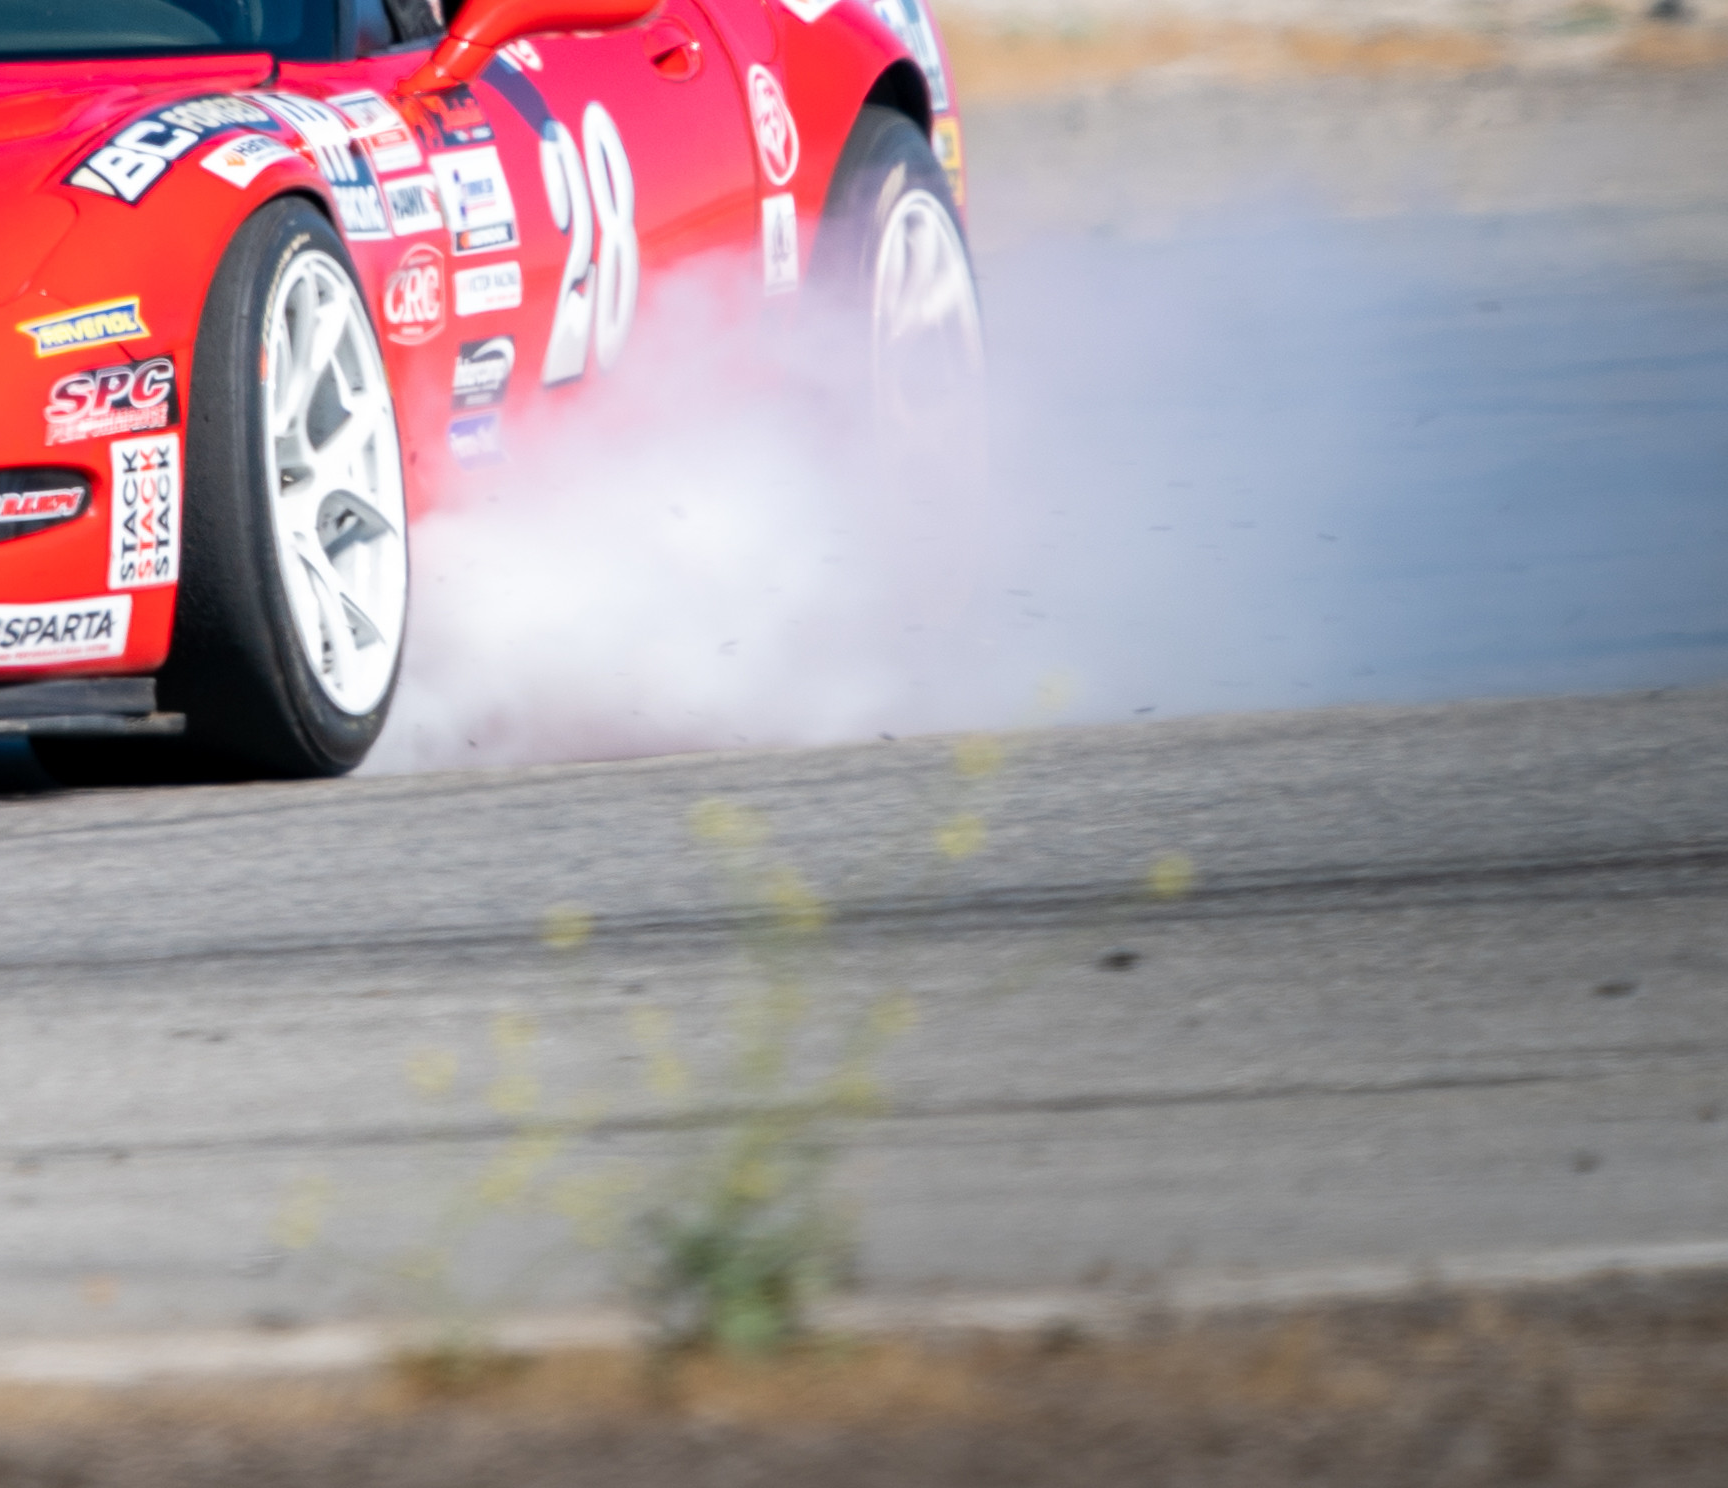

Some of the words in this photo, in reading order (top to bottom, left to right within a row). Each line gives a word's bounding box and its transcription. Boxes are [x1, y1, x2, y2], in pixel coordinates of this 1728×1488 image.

[88, 120, 199, 202] BC
[384, 265, 441, 324] CRC
[539, 100, 642, 390] 28
[44, 357, 174, 424] SPC
[120, 449, 139, 581] STACK
[138, 447, 156, 579] STACK
[155, 444, 171, 577] STACK
[0, 609, 116, 649] SPARTA
